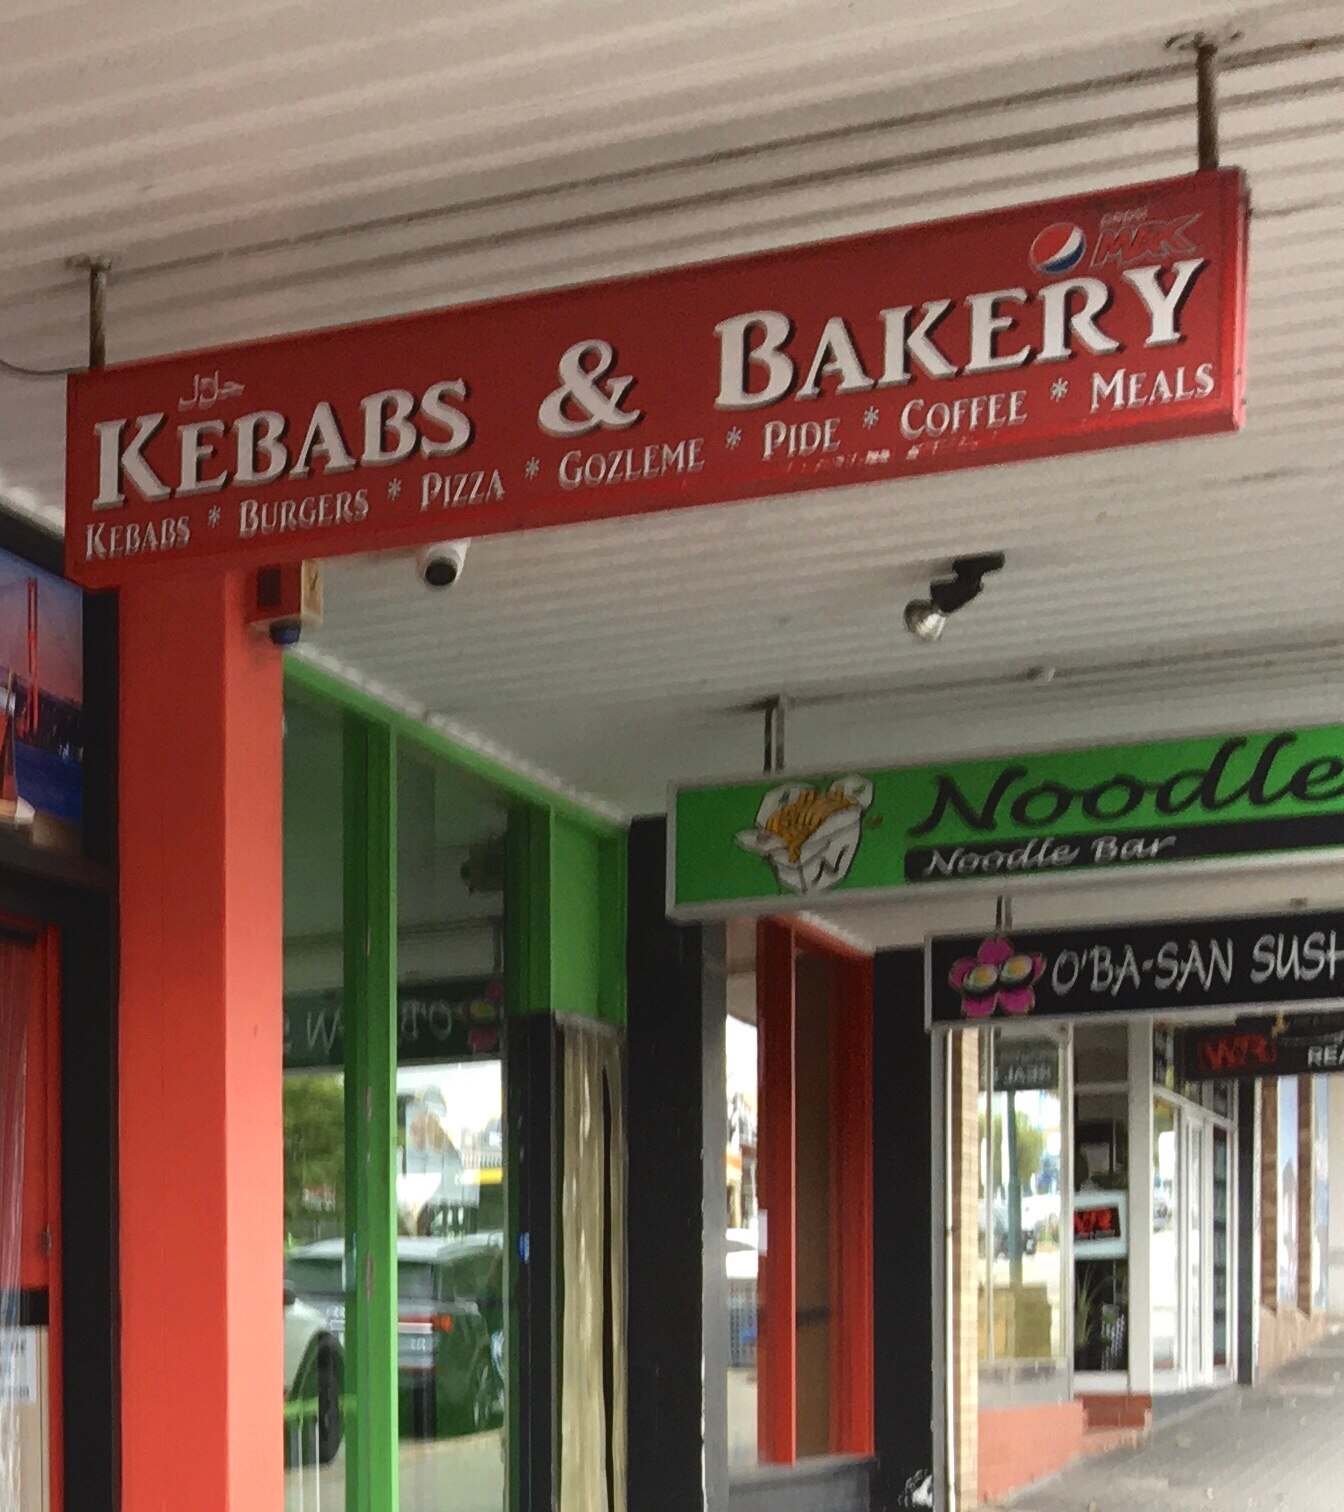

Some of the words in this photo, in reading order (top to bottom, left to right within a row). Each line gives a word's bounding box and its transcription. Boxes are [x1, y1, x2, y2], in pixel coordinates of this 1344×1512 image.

[91, 376, 476, 512] KEBABS
[538, 338, 644, 437] &
[714, 257, 1207, 411] BAKERY
[85, 515, 190, 561] KEBABS
[239, 488, 369, 538] BURGERS
[421, 468, 506, 512] PIZZA
[559, 438, 706, 490] GOZLEME
[763, 418, 841, 461] PIDE
[900, 390, 1028, 440] COFFEE
[1089, 363, 1214, 413] MEALS
[922, 837, 1080, 877] Noodle
[1091, 835, 1177, 863] Bar
[1051, 937, 1233, 997] O'BA-SAN
